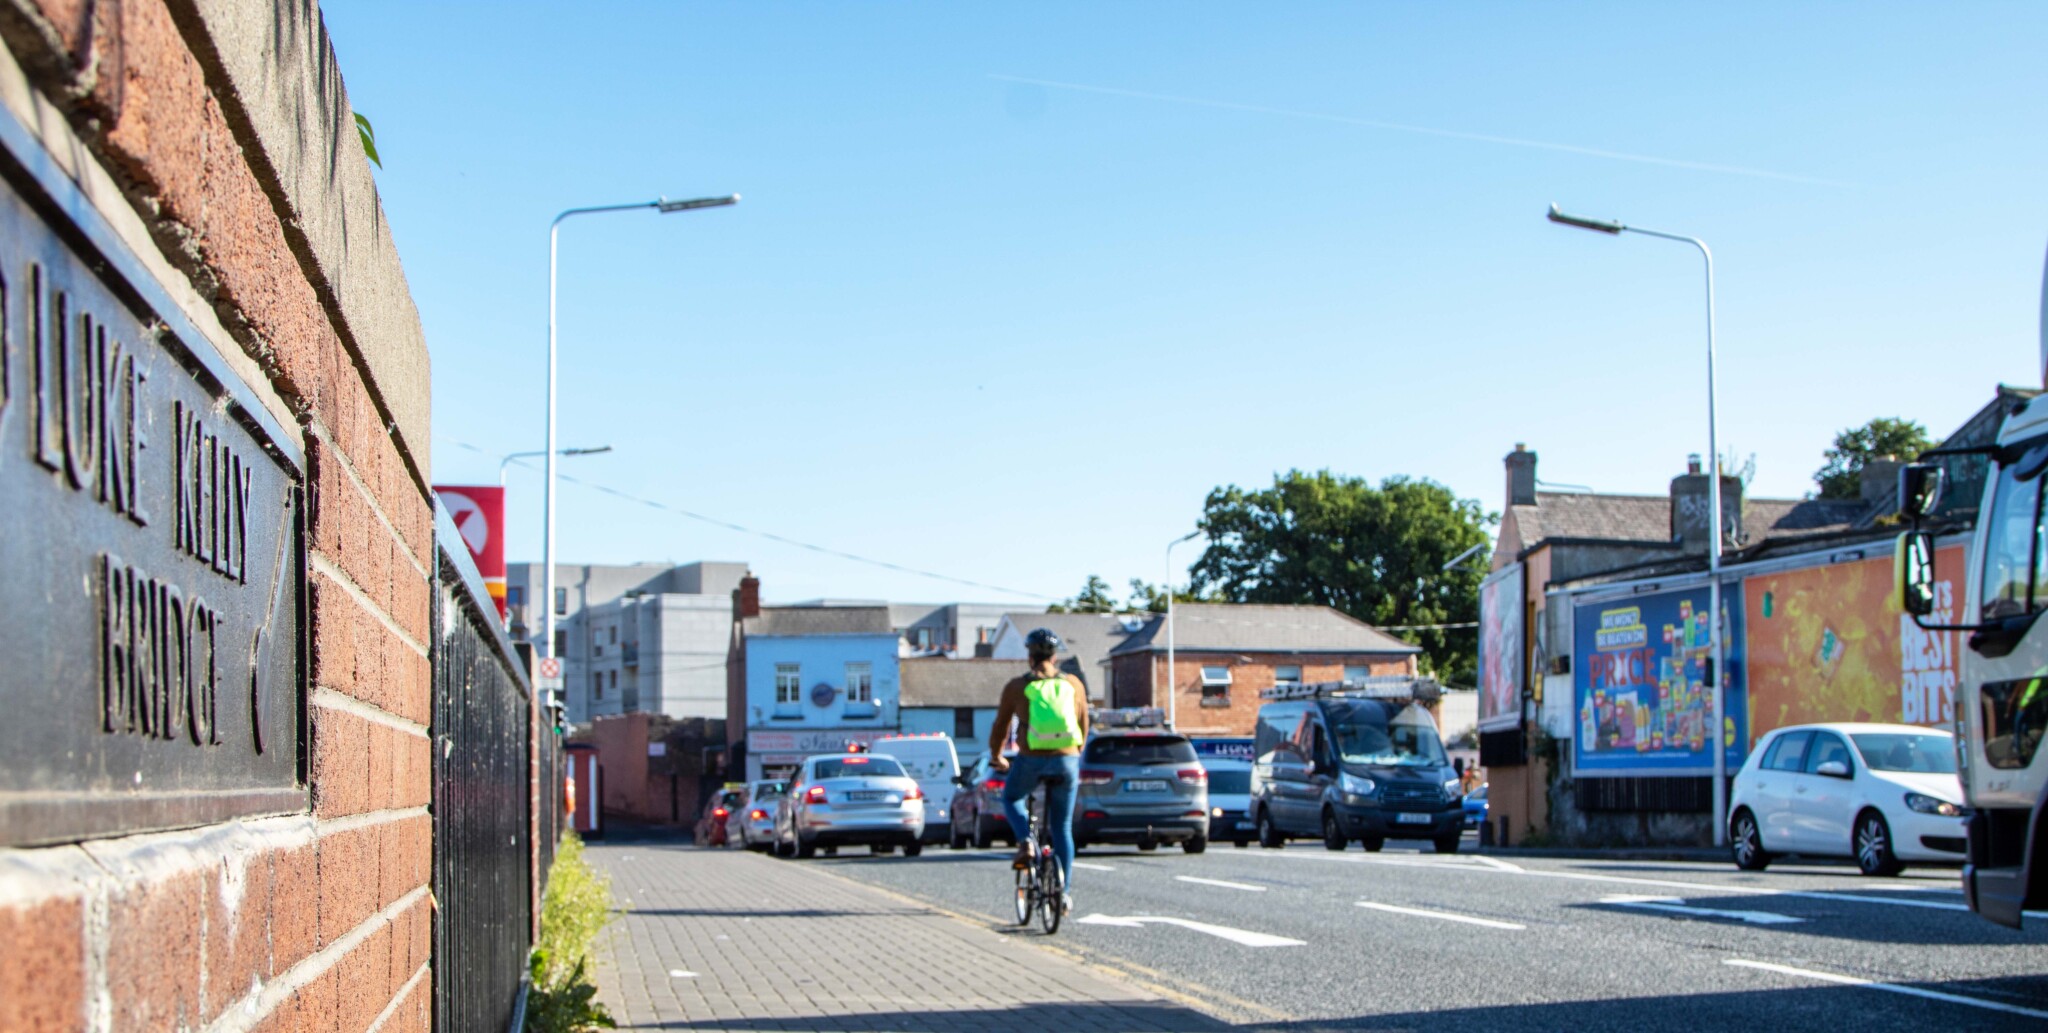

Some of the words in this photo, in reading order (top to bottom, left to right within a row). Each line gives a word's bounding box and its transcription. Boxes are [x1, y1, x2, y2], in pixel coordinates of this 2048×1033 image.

[28, 261, 149, 527] LUKE
[172, 399, 252, 586] KELLY
[100, 552, 224, 748] BRIDGE
[1588, 648, 1658, 689] PRICE
[1901, 610, 1953, 671] BEST
[1902, 669, 1956, 724] BITS
